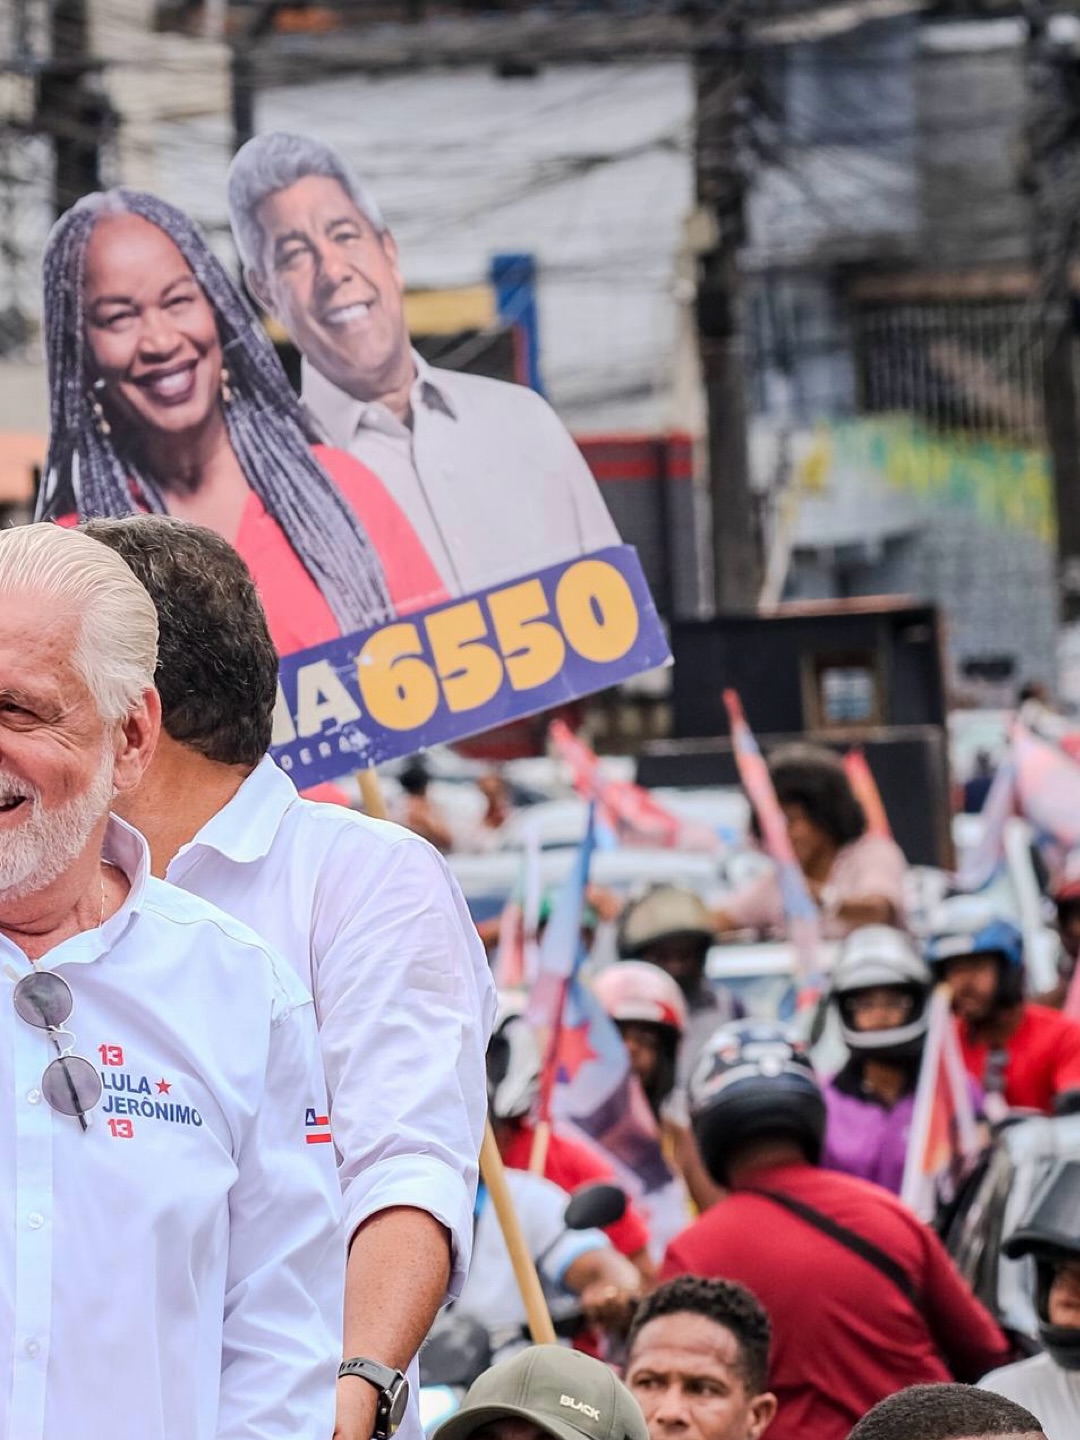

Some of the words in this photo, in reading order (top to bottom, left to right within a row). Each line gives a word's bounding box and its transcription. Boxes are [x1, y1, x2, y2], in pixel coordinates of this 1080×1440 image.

[358, 560, 639, 731] 6550
[98, 1043, 125, 1067] 13
[100, 1071, 152, 1096] LULA
[102, 1095, 203, 1127] JERÔNIMO
[107, 1118, 135, 1139] 13
[560, 1393, 601, 1421] BLACK
